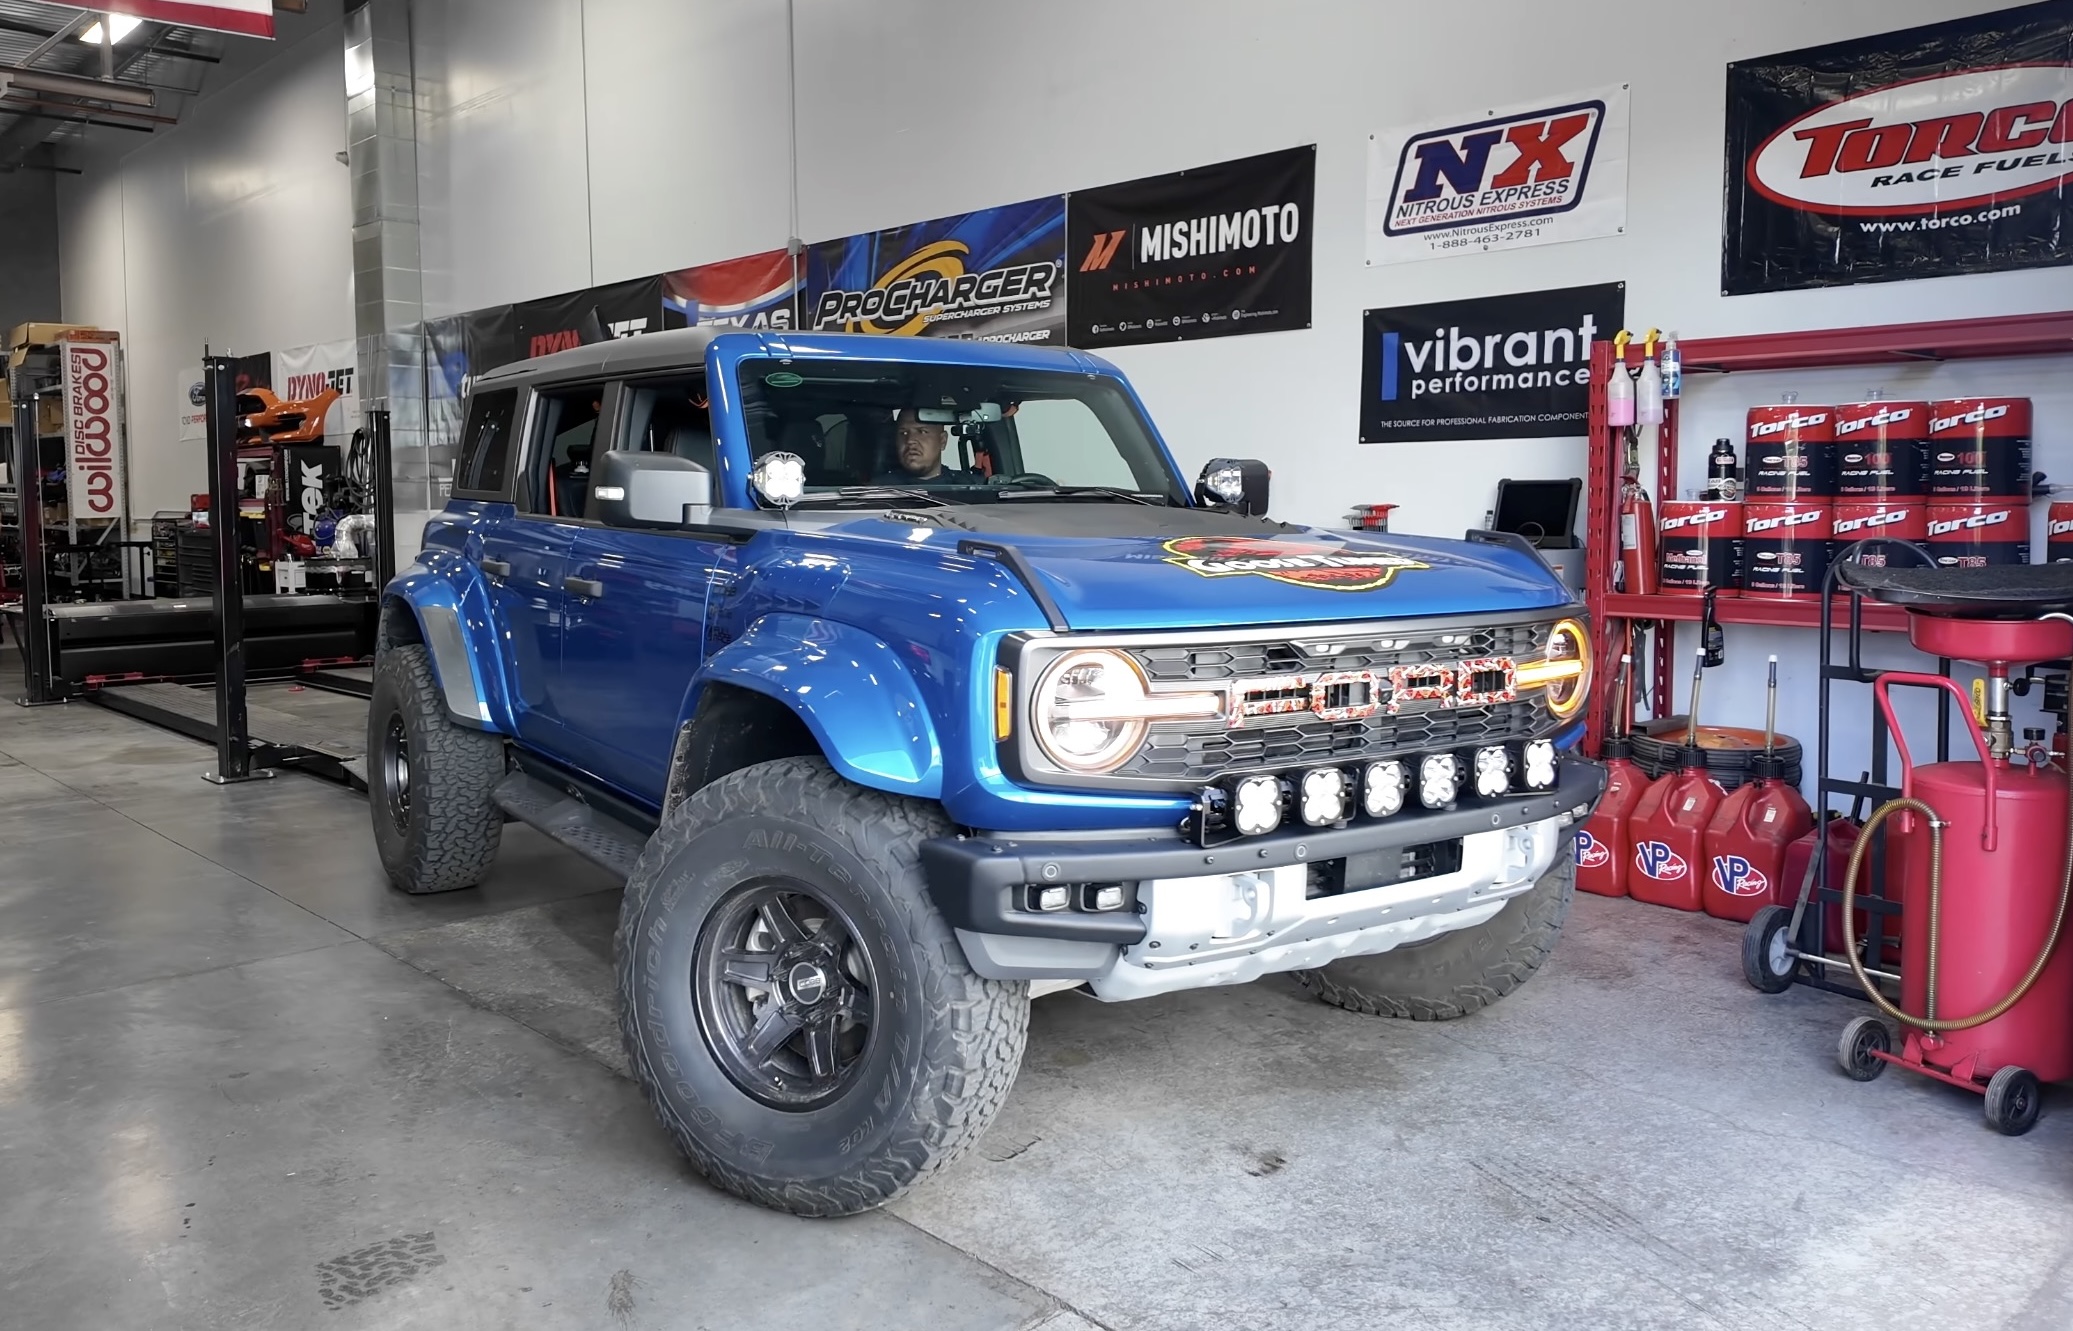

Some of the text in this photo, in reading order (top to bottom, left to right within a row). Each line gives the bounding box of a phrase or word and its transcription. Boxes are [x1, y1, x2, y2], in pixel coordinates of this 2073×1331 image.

[1402, 112, 1590, 204] NX
[1870, 153, 2073, 188] RACE FUEL
[1394, 196, 1563, 227] NEXT GENERATION NITROUS SYSTEMS
[1396, 178, 1570, 219] NITROUS EXPRESS
[1140, 202, 1300, 263] MISHIMOTO
[1423, 217, 1554, 241] www.NitrousExpress.com
[1859, 203, 2021, 233] www.torco.com
[1430, 229, 1541, 250] 1-888-463-2781
[923, 300, 1051, 323] SUPERCHARGER SYSTEMS
[1404, 314, 1598, 373] vibrant
[1411, 367, 1591, 399] performance
[71, 354, 86, 455] DISC BRAKES
[1381, 412, 1590, 428] THE SOURCE FOR PROFESSIONAL FABRICATION COMPONENT
[70, 347, 114, 513] wilwood
[1229, 656, 1518, 729] FORD
[1574, 830, 1594, 866] P
[1636, 840, 1672, 878] VP
[1713, 855, 1750, 894] VP
